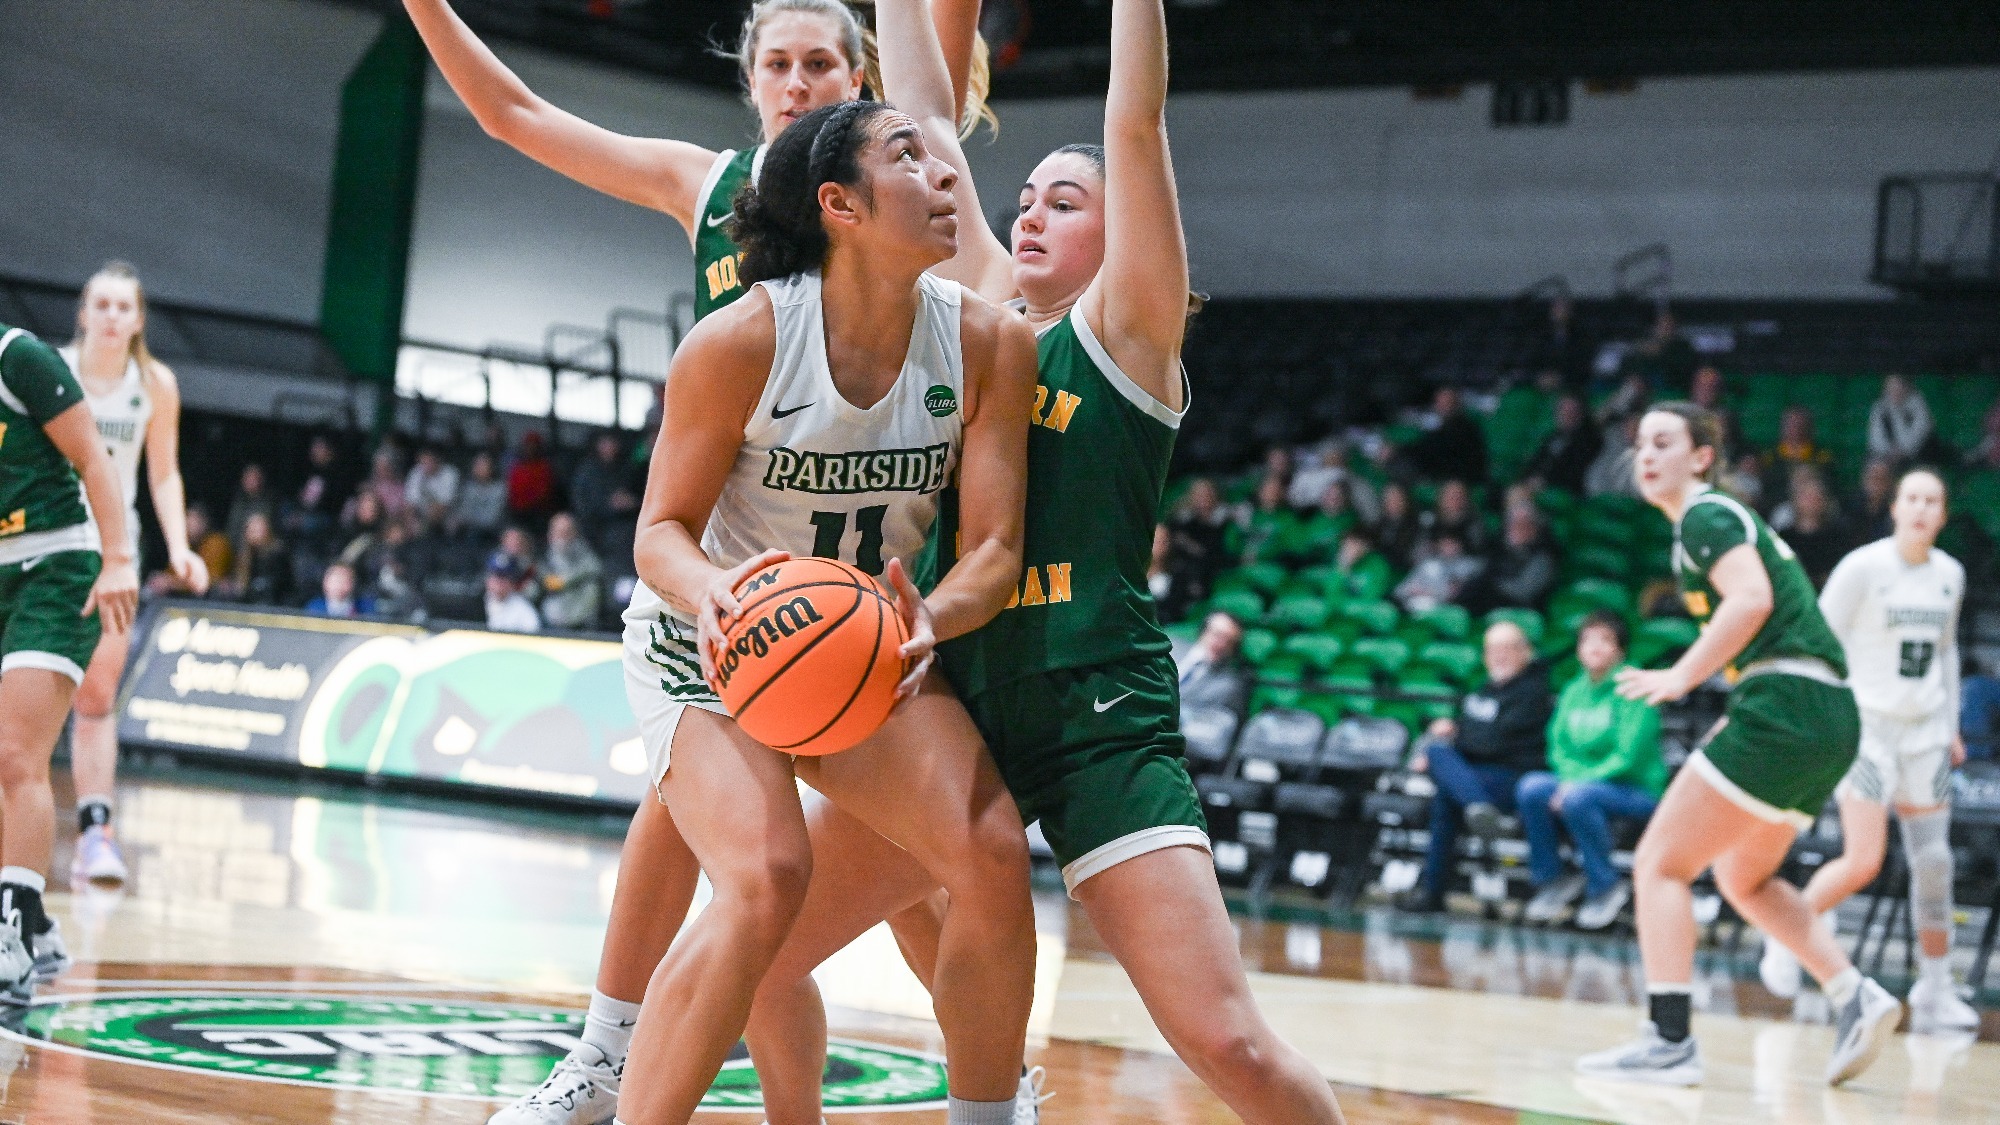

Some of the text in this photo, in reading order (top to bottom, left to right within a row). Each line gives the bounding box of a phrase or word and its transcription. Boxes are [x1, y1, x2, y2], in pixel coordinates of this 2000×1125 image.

[763, 442, 950, 496] PARKSIDE
[809, 504, 890, 577] 11
[719, 595, 824, 690] Wilson
[201, 1030, 583, 1056] LIAC
